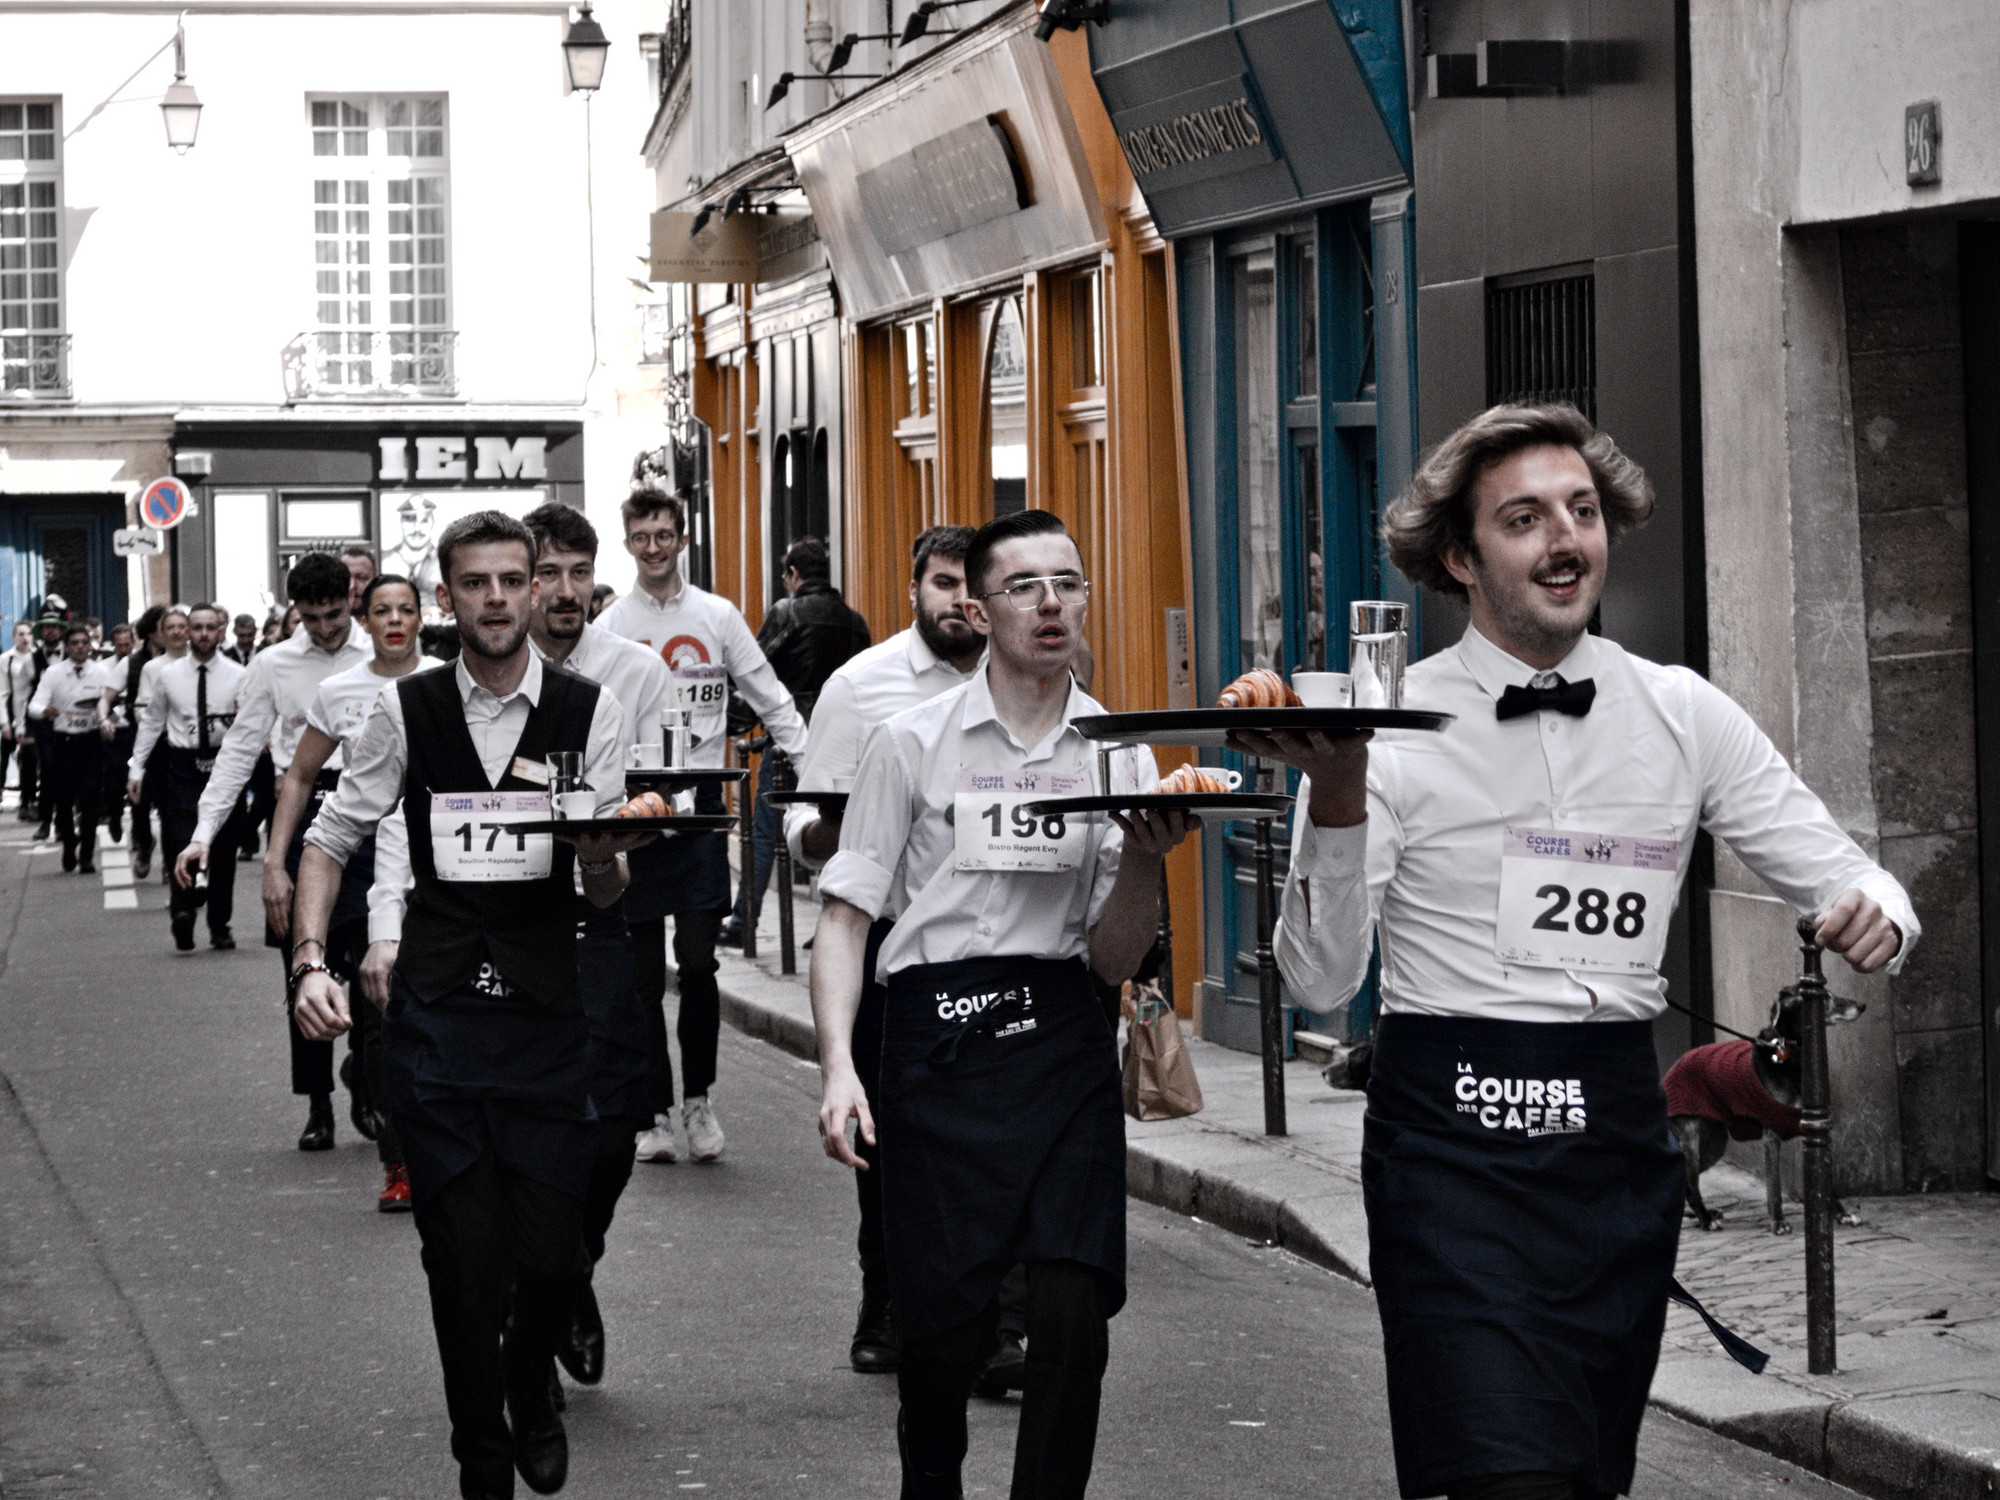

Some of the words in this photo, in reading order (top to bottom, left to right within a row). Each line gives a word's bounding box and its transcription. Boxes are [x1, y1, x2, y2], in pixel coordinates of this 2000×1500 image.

[1119, 122, 1184, 176] KOREAN
[1173, 97, 1261, 161] COSMETICS
[1908, 113, 1931, 174] 26
[378, 436, 548, 481] IEM
[686, 683, 724, 702] 189
[972, 776, 1004, 784] COURSE
[988, 843, 1012, 851] Bistro
[1042, 845, 1059, 855] Evry
[1526, 835, 1572, 848] COURSE
[1532, 884, 1647, 939] 288
[935, 992, 949, 1001] LA
[1457, 1062, 1473, 1074] LA
[1455, 1075, 1586, 1108] COURSE
[1456, 1103, 1478, 1114] DES
